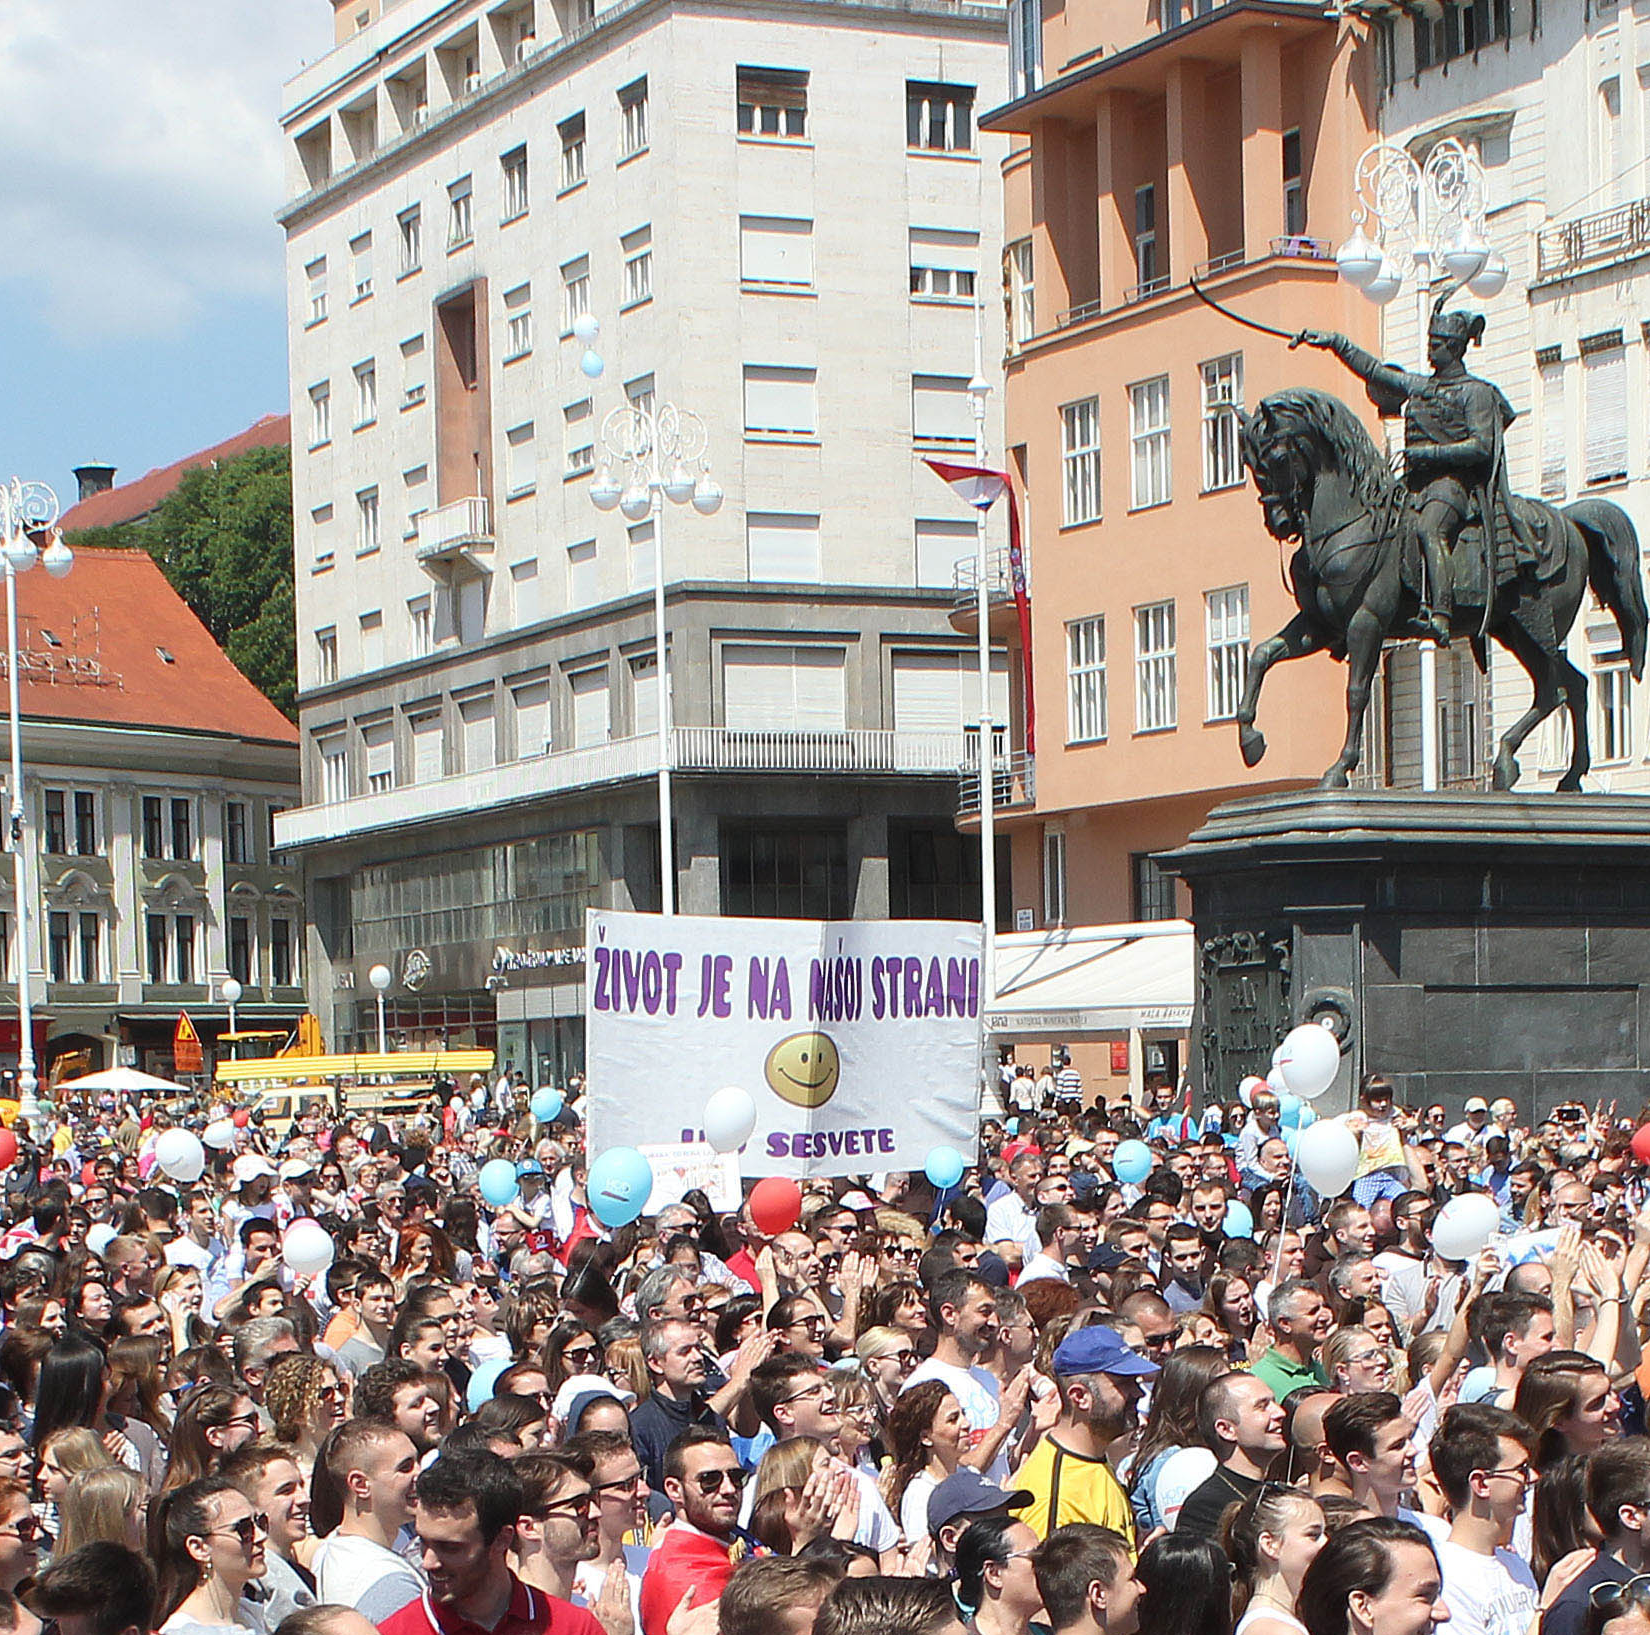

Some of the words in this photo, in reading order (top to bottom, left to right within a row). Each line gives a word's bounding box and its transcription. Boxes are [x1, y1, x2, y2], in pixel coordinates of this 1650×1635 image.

[594, 924, 683, 1016] ŽIVOT
[697, 954, 733, 1019] JE
[748, 955, 792, 1021] NA
[808, 936, 862, 1023] NAŠOJ
[871, 955, 980, 1020] STRANI
[766, 1128, 896, 1159] SESVETE
